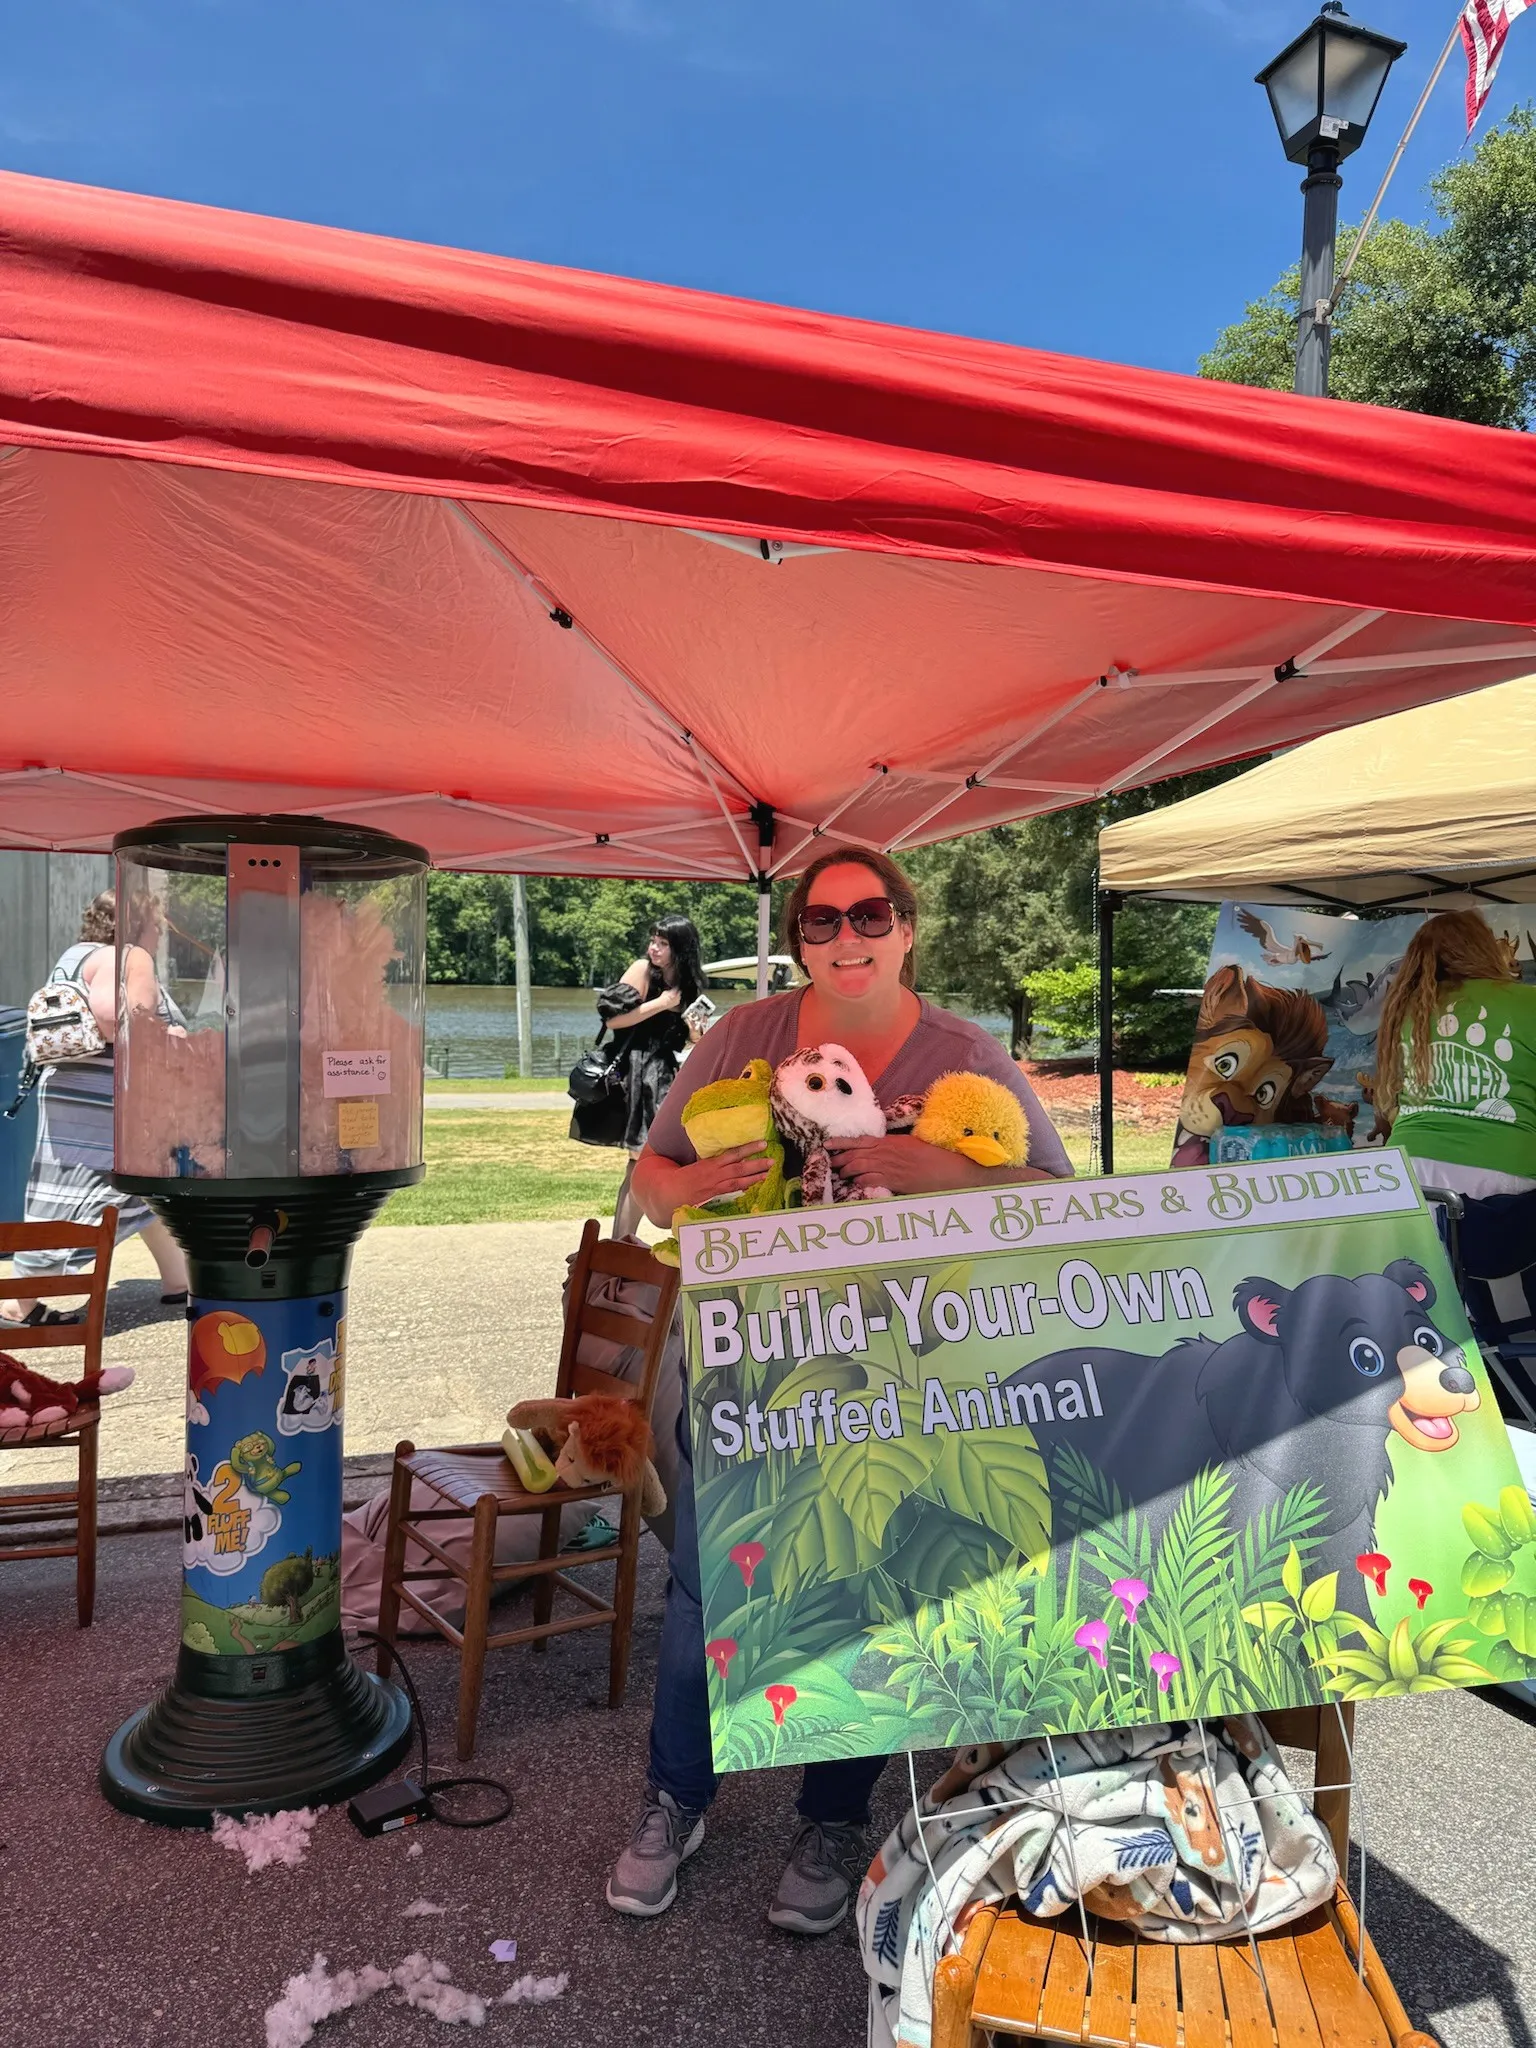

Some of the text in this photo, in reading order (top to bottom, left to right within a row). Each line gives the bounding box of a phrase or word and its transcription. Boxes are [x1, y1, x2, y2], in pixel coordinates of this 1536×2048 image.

[327, 1055, 387, 1066] Please ask for
[695, 1163, 1401, 1275] BEAR-OLINA BEARS & BUDDIES
[698, 1258, 1214, 1369] Build-Your-Own
[711, 1363, 1105, 1457] Stuffed Animal
[212, 1463, 242, 1514] 2
[207, 1508, 252, 1535] FLUFF
[214, 1528, 250, 1555] ME!
